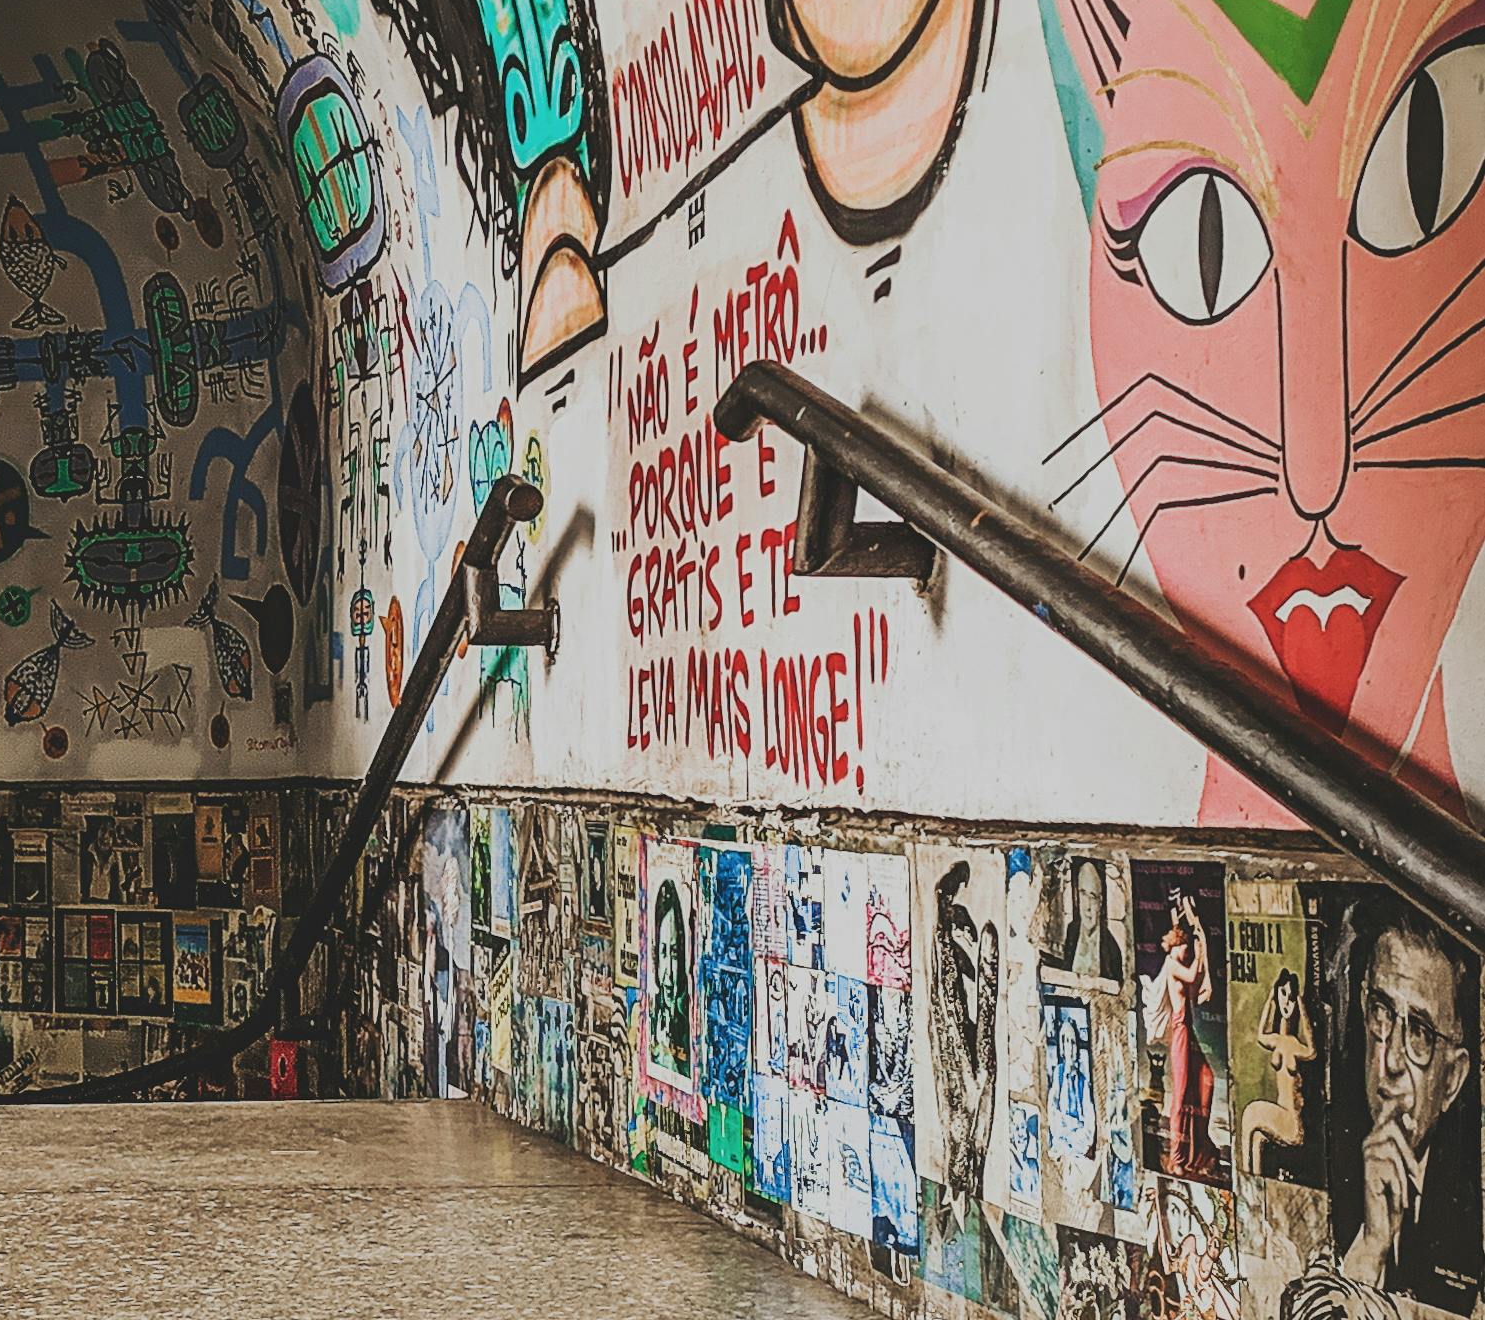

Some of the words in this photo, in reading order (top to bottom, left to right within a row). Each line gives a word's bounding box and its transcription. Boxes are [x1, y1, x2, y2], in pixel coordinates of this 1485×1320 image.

[683, 283, 699, 415] É
[625, 534, 723, 647] GRÁTIS
[737, 532, 757, 627] E
[761, 520, 801, 618] TE
[627, 660, 676, 751] LEVA
[686, 648, 753, 760] MAIS
